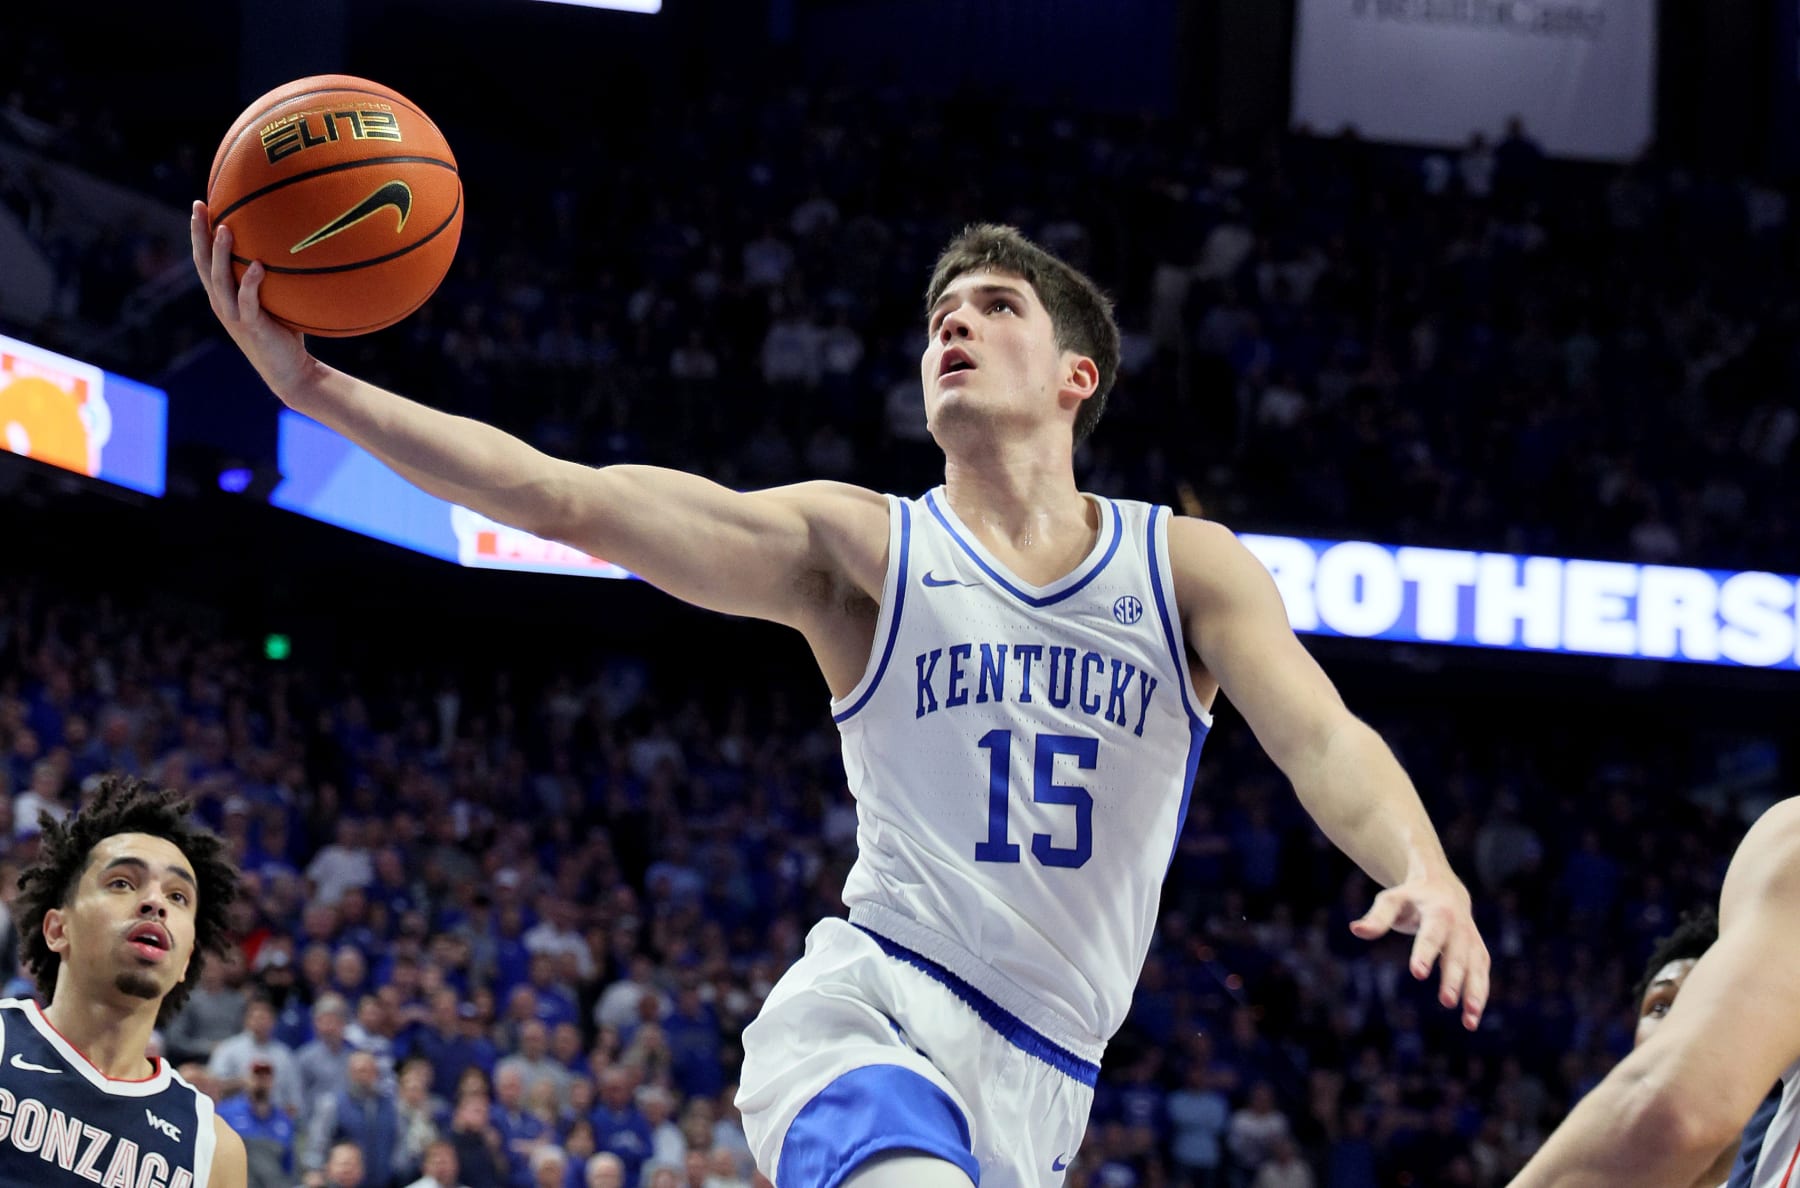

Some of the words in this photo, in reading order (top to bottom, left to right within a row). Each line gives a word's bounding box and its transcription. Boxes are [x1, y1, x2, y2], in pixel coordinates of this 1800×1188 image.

[261, 110, 402, 165] ELITE
[1113, 595, 1143, 624] SEC
[1237, 533, 1800, 666] ROTHERS
[915, 643, 1158, 737] KENTUCKY
[974, 729, 1100, 869] 15
[145, 1108, 182, 1143] WCC
